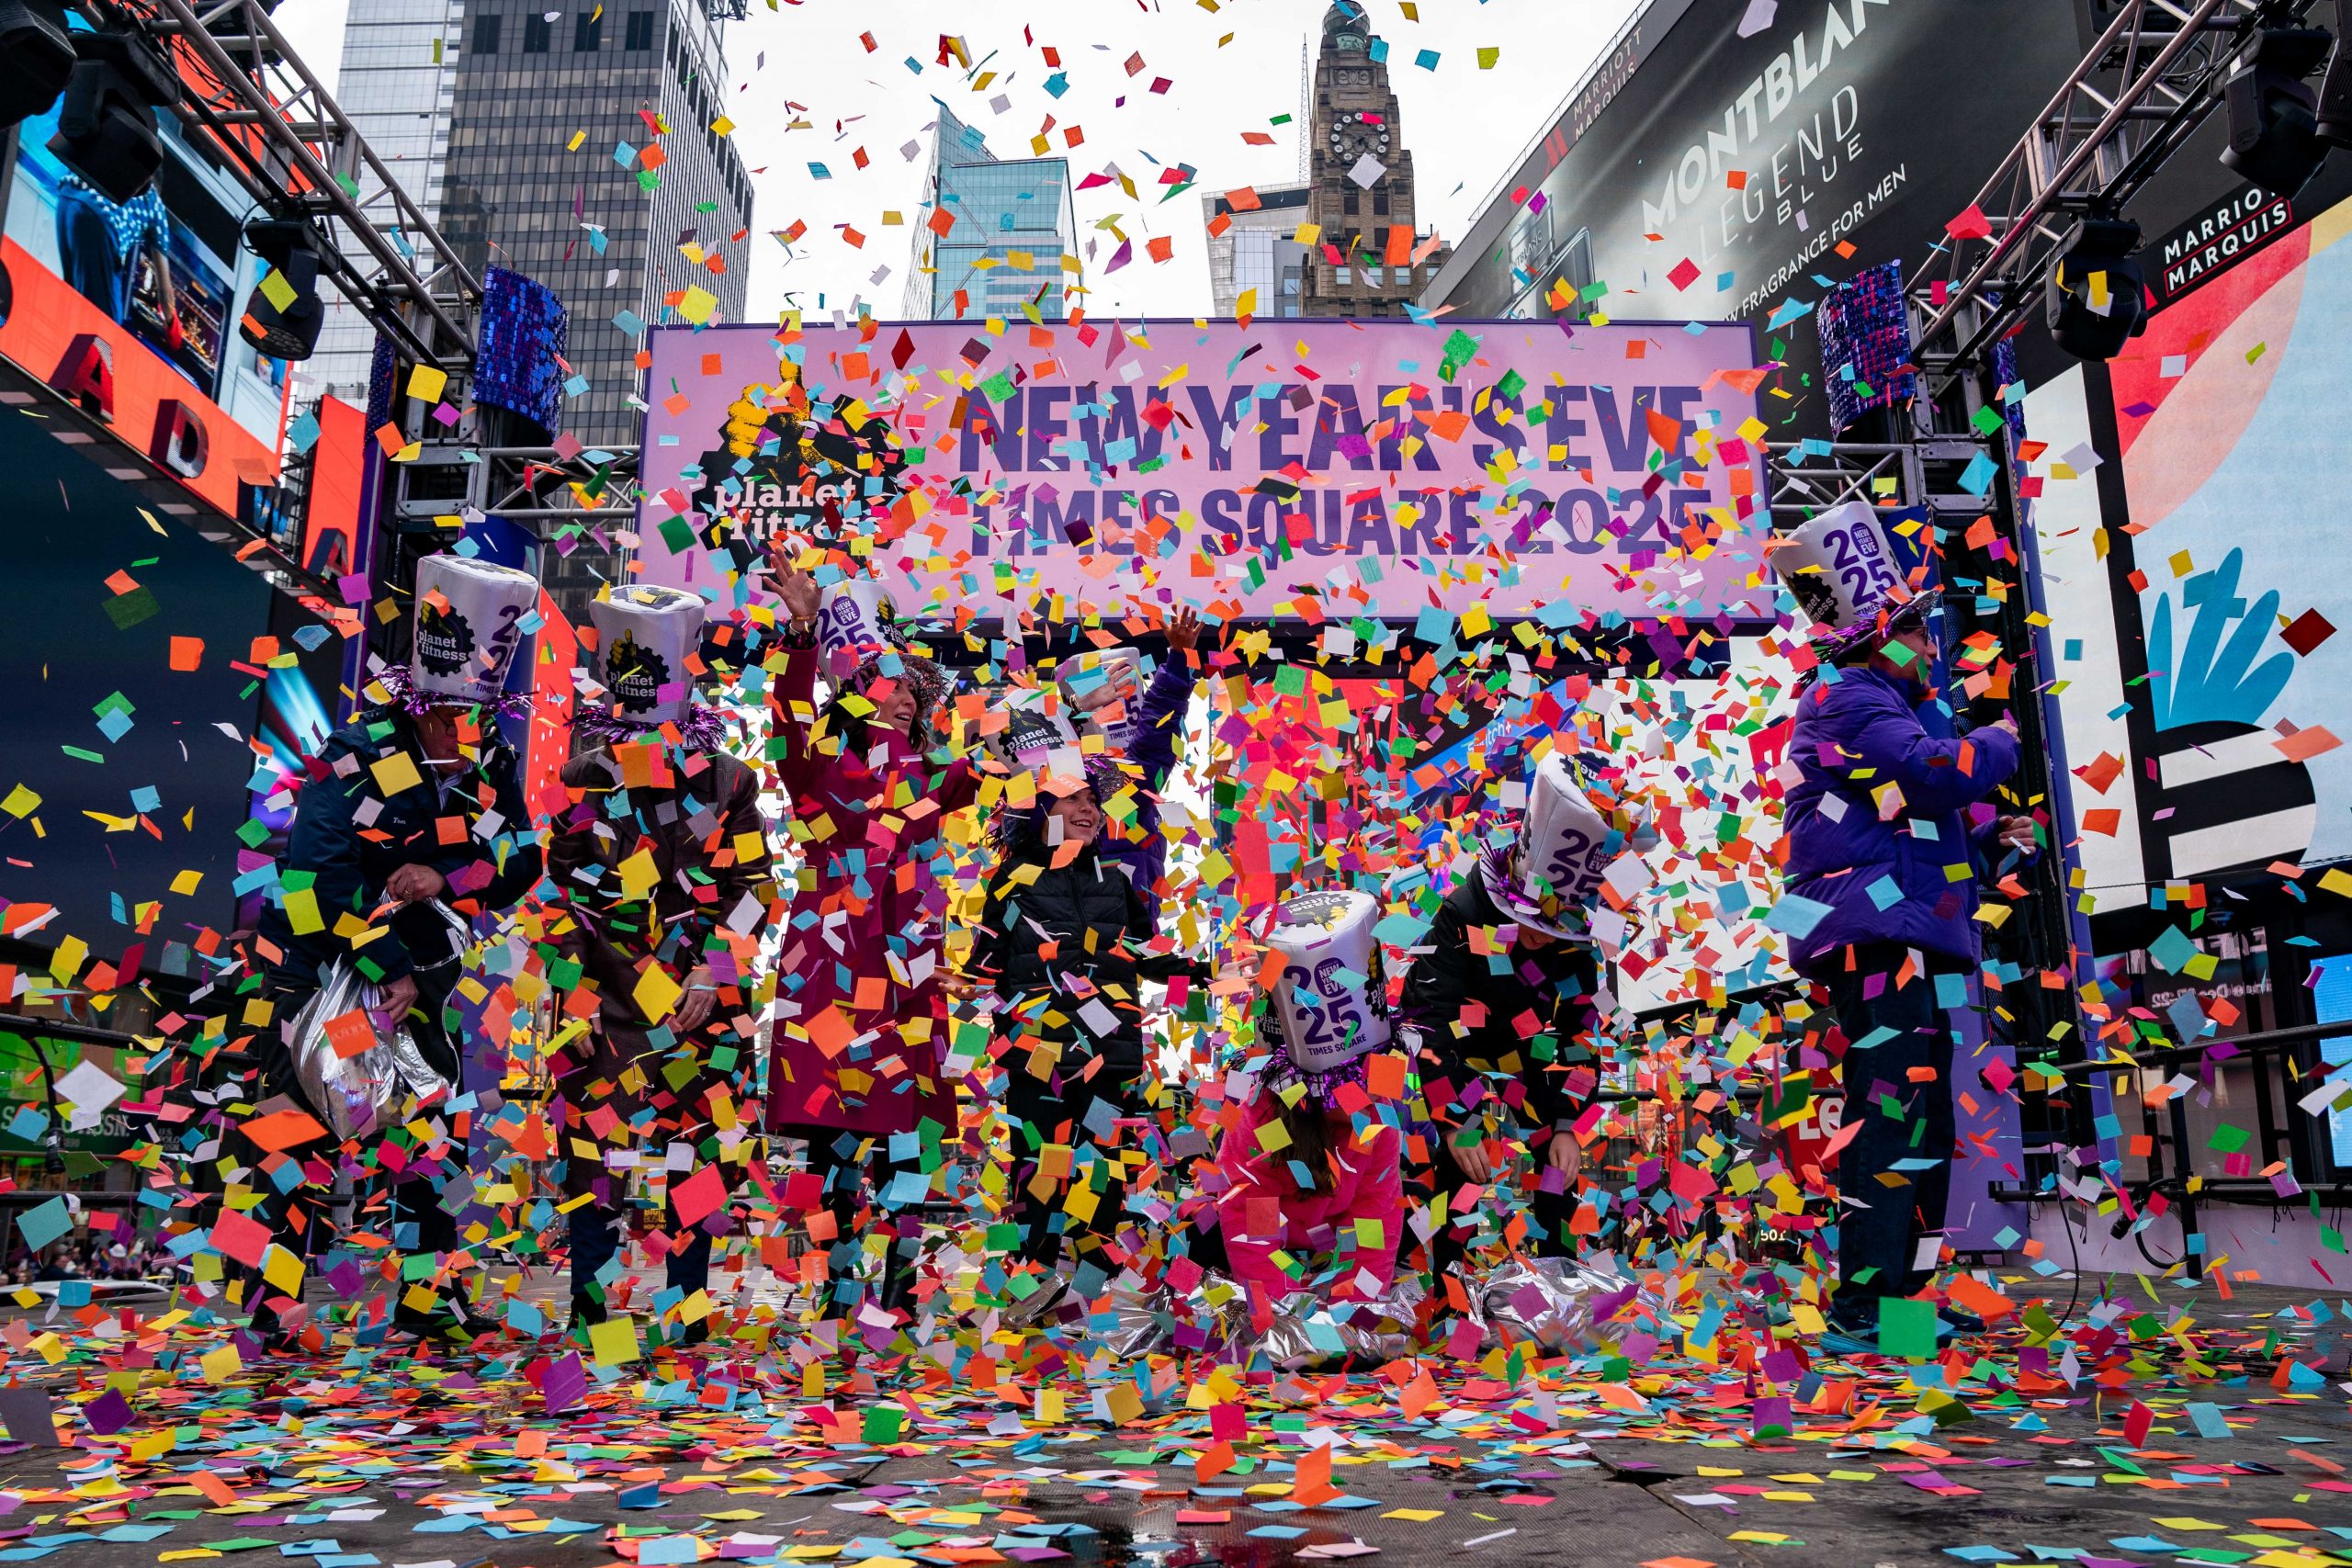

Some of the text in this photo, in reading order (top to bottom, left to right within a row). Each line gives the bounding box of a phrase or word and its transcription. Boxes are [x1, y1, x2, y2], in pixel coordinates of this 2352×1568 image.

[1573, 27, 1642, 120] MARRIOTT
[1575, 62, 1635, 141] MARQUIS
[1699, 85, 1859, 265] LEGEND
[1777, 132, 1863, 225] BLUE
[1742, 163, 1906, 317] FRAGRANCE FOR MEN
[2165, 188, 2276, 265] MARRIO
[2168, 202, 2287, 291] MARQUIS
[959, 383, 1709, 472] NEW YEAR'S EVE
[714, 476, 856, 516] planet
[972, 488, 1722, 570] TIMES SQUARE 2025
[1853, 527, 1871, 539] NEW
[1823, 522, 1880, 570] 20
[1860, 541, 1878, 555] EVE
[1841, 557, 1897, 608] 25
[834, 600, 852, 612] NEW
[840, 613, 858, 625] EVE
[418, 629, 457, 649] planet
[421, 642, 468, 661] fitness
[615, 682, 657, 697] fitnes
[1006, 728, 1048, 753] planet
[1013, 736, 1061, 752] fitness
[1109, 730, 1127, 740] TIMES
[393, 817, 406, 825] Tom
[1295, 995, 1362, 1045] 25
[1307, 1045, 1333, 1056] TIMES
[1760, 1228, 1787, 1242] 501
